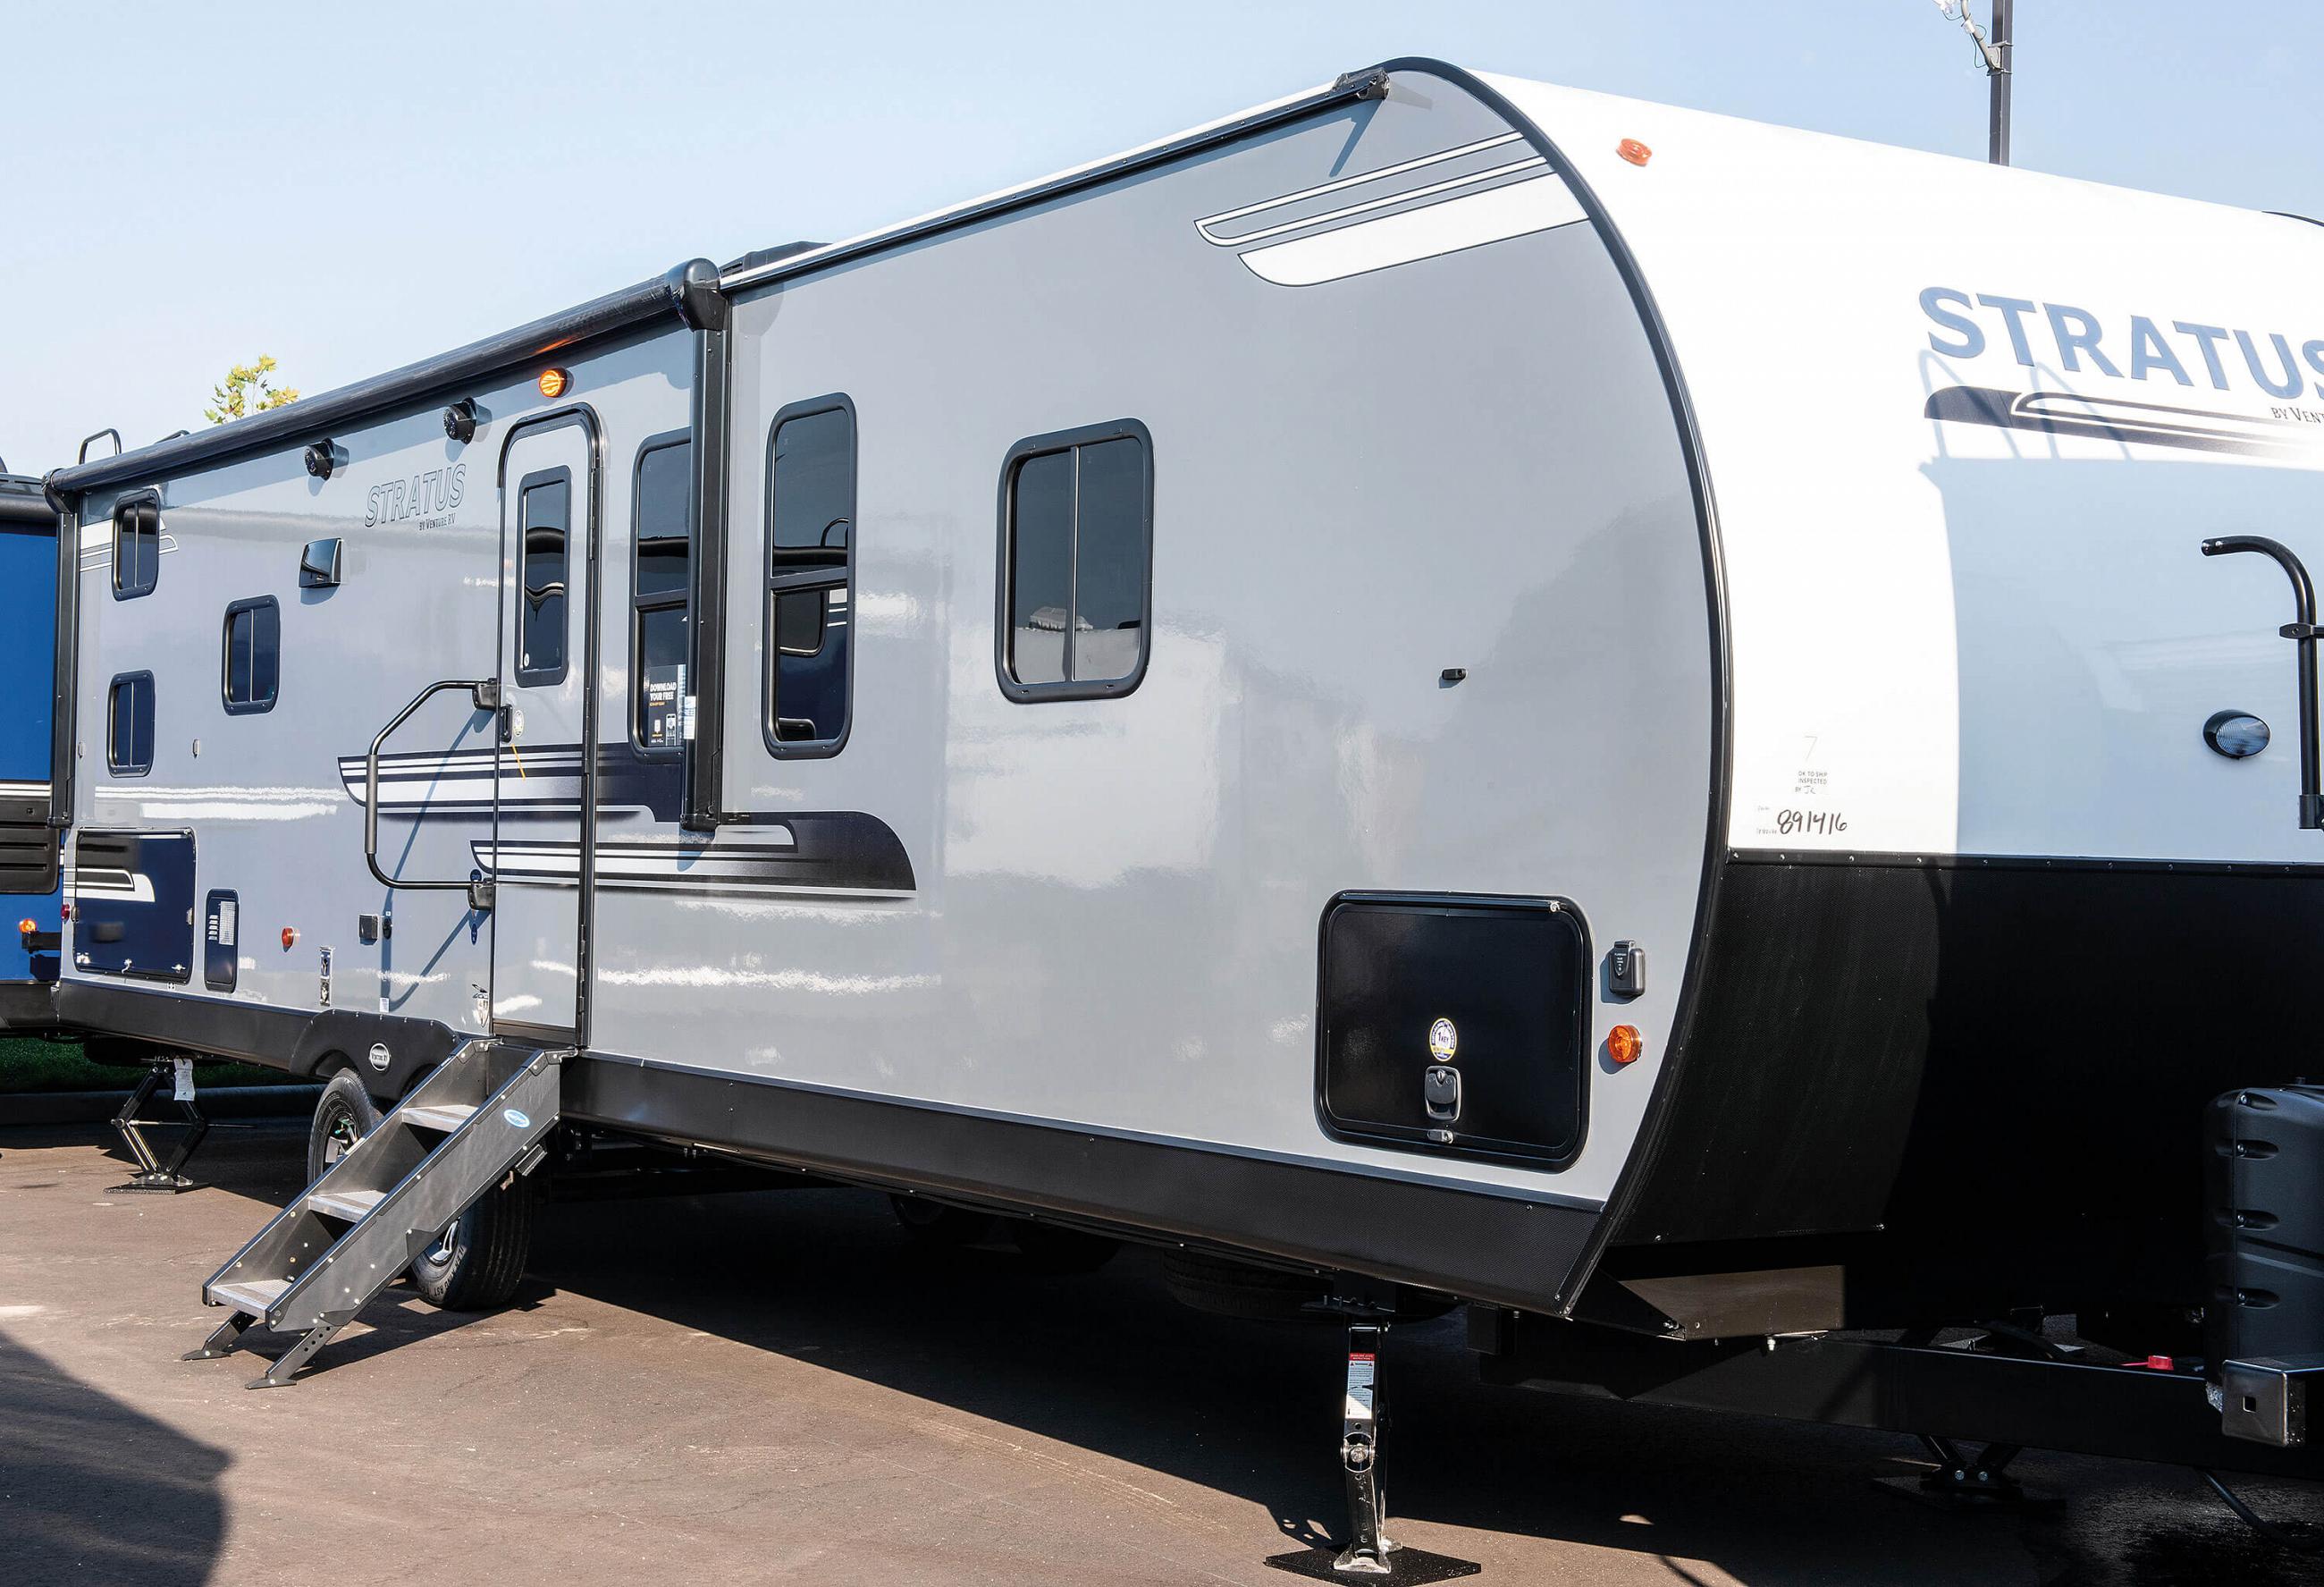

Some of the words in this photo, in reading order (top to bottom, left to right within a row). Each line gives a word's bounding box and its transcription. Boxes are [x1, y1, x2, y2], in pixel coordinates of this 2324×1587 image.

[2270, 407, 2288, 420] BY
[365, 463, 467, 528] STRATUS
[650, 682, 677, 692] DOWNLOAD
[650, 692, 663, 701] YOUR
[663, 691, 674, 700] FREE
[1777, 809, 1847, 835] 891416
